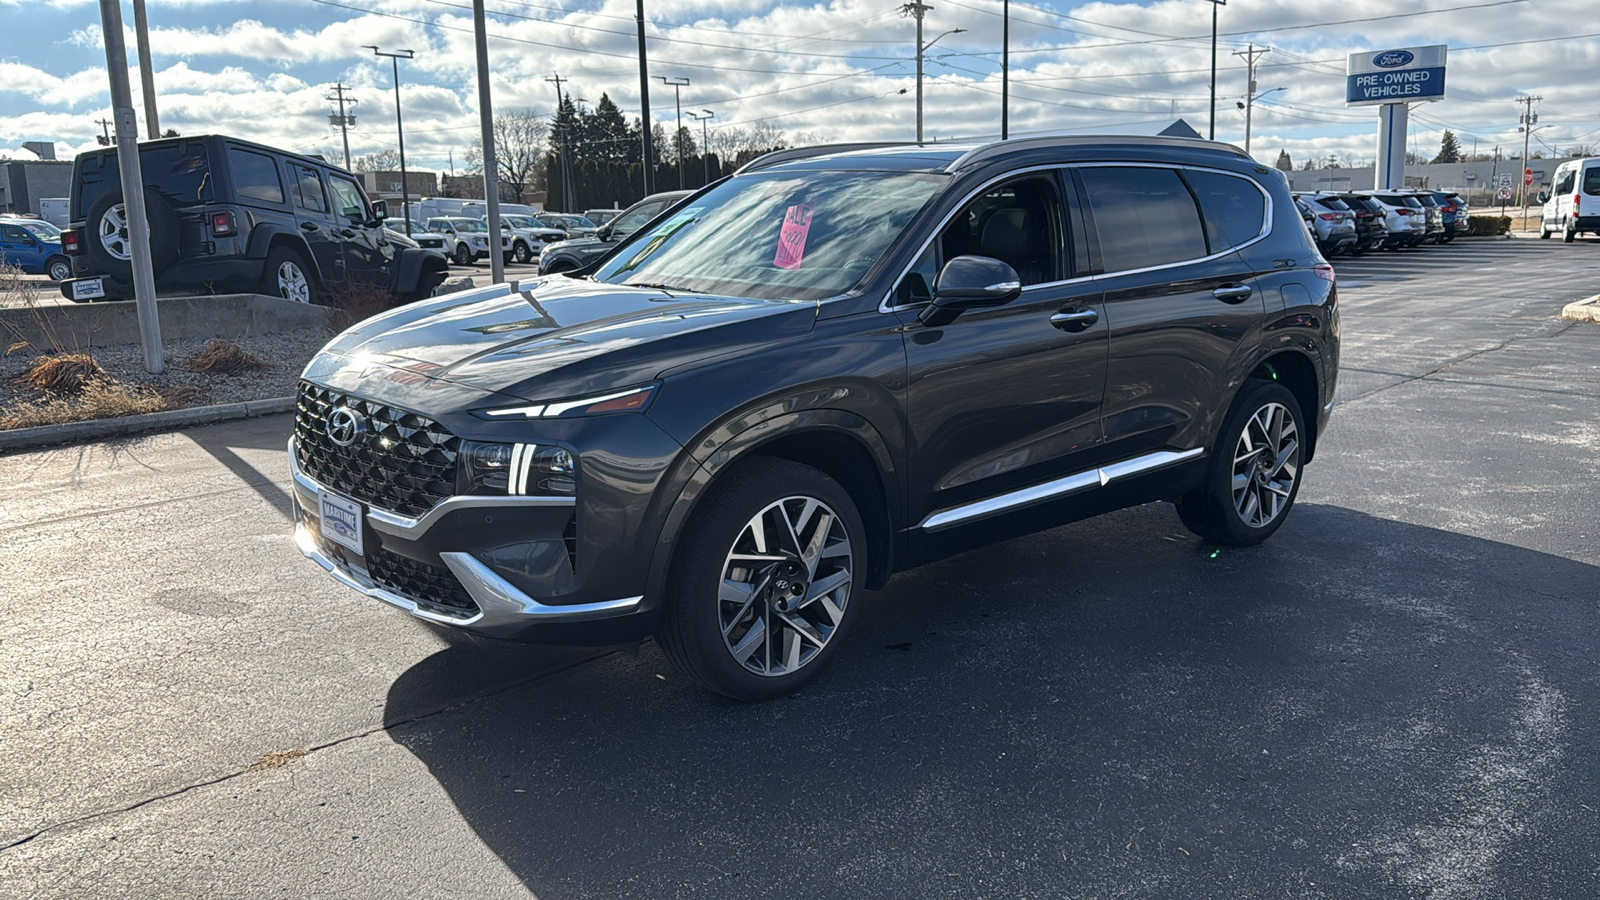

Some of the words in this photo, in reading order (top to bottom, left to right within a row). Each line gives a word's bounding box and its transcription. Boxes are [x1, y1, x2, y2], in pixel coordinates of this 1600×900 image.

[1380, 53, 1405, 65] Ford
[1363, 83, 1421, 98] VEHICLES
[324, 502, 355, 530] MARITIME
